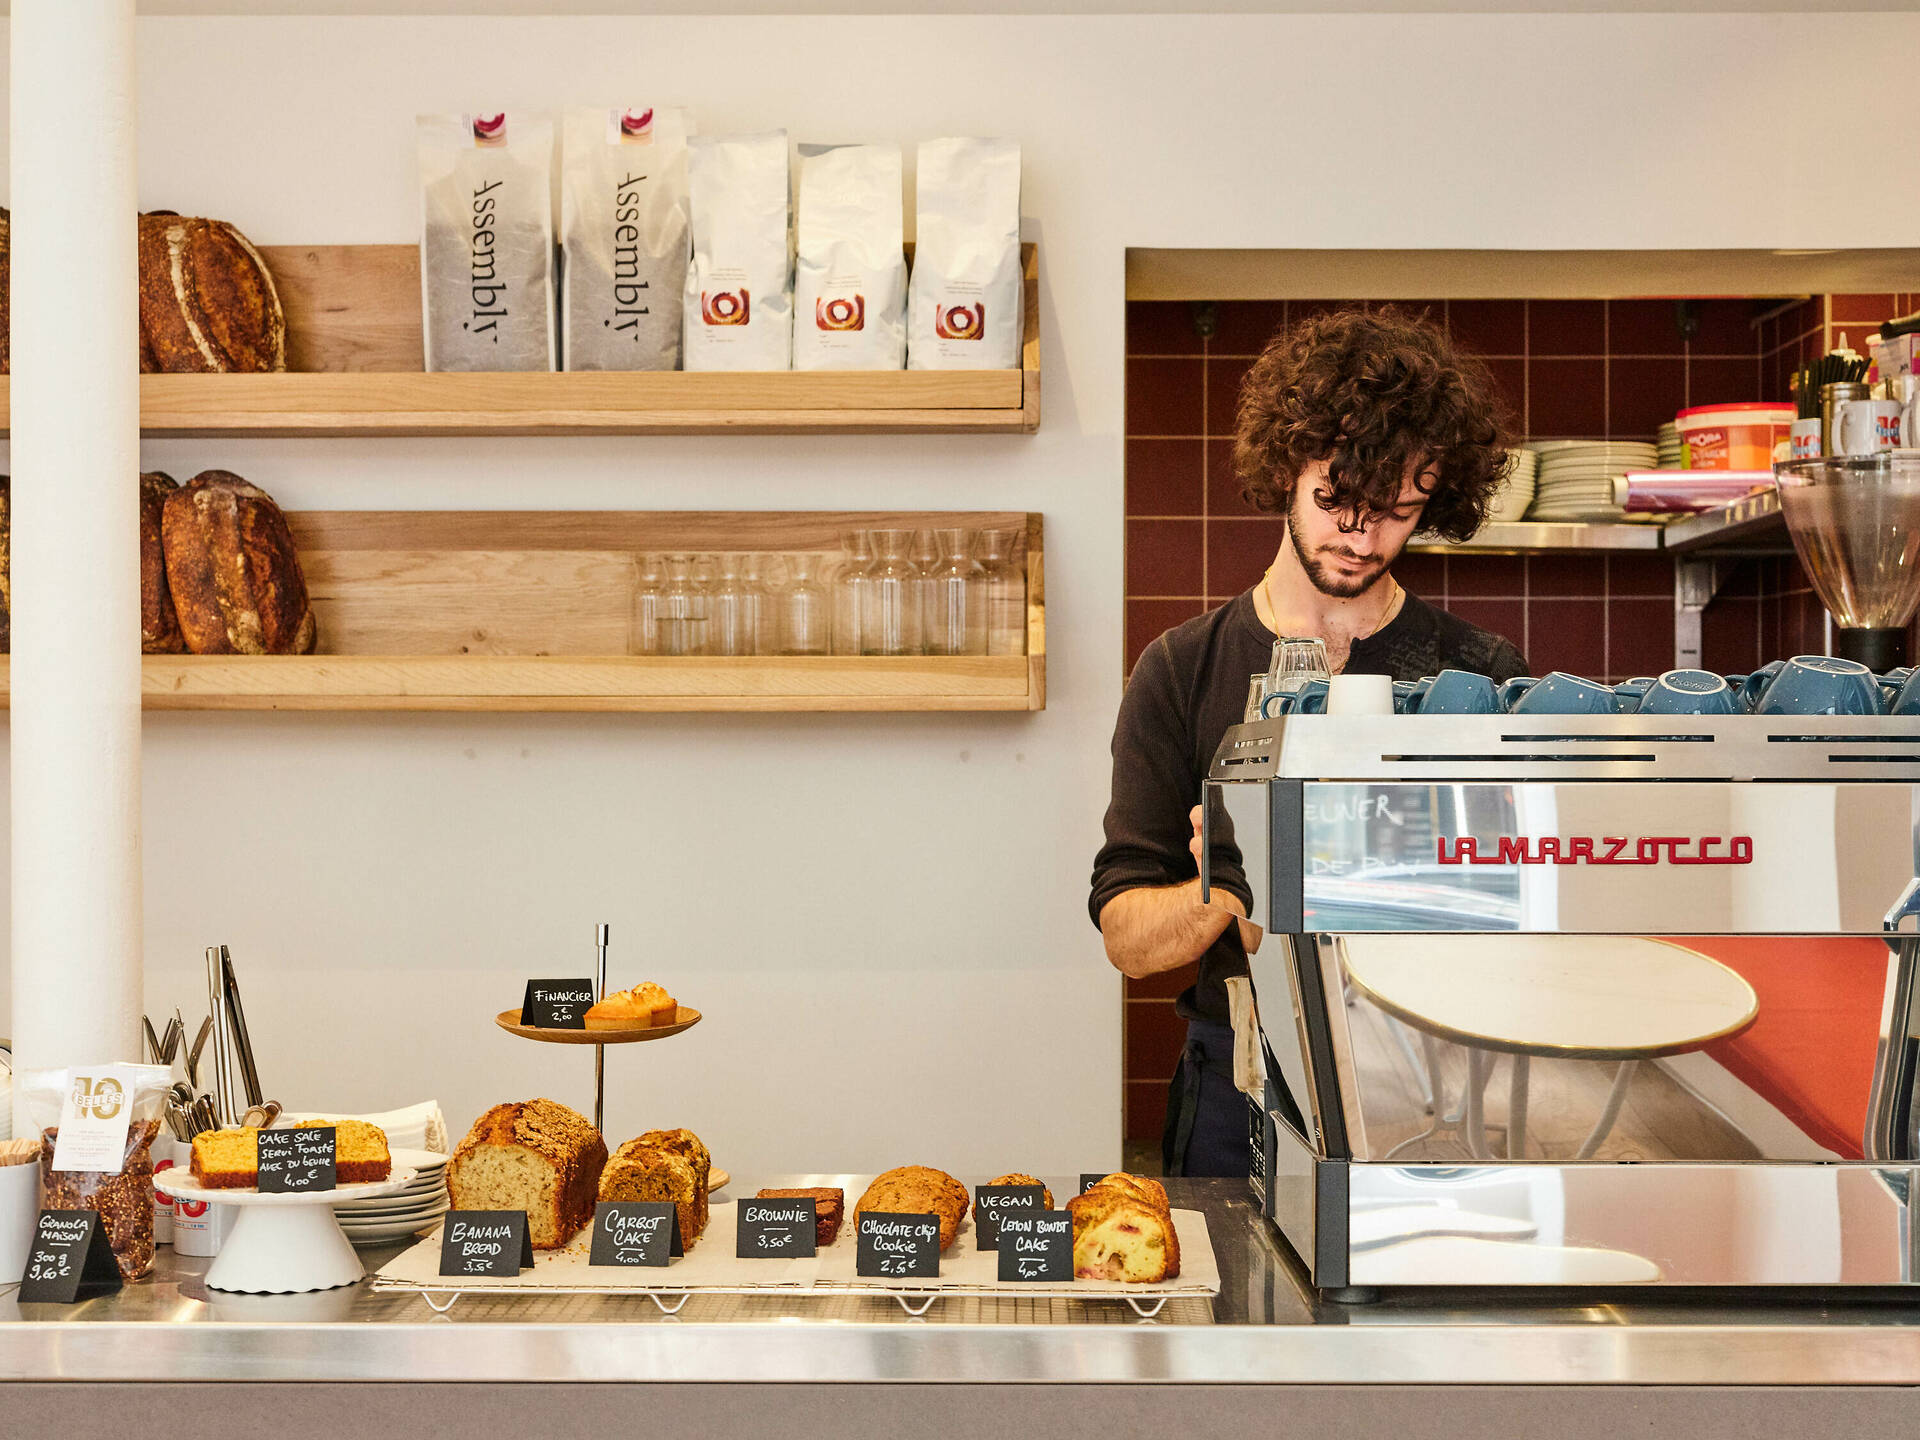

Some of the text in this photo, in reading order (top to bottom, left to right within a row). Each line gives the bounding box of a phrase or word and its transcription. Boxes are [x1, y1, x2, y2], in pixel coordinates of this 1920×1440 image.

[1437, 836, 1753, 865] LA MARZOCCO
[534, 988, 593, 1003] FINANCIER
[73, 1076, 124, 1120] 10
[76, 1091, 124, 1107] BELLES
[257, 1132, 290, 1146] CAKE
[258, 1161, 283, 1172] AVEC
[980, 1194, 1034, 1209] VEGAN
[604, 1208, 667, 1233] CARROT
[745, 1204, 809, 1223] BROWNIE
[39, 1214, 89, 1231] GRANOLA
[40, 1229, 85, 1243] MAISON
[450, 1221, 512, 1243] BANANA
[613, 1229, 652, 1247] CAKE
[461, 1242, 502, 1257] BREAD
[873, 1234, 918, 1254] Cookie
[1015, 1235, 1051, 1253] CAKE
[33, 1251, 68, 1268] 300 g
